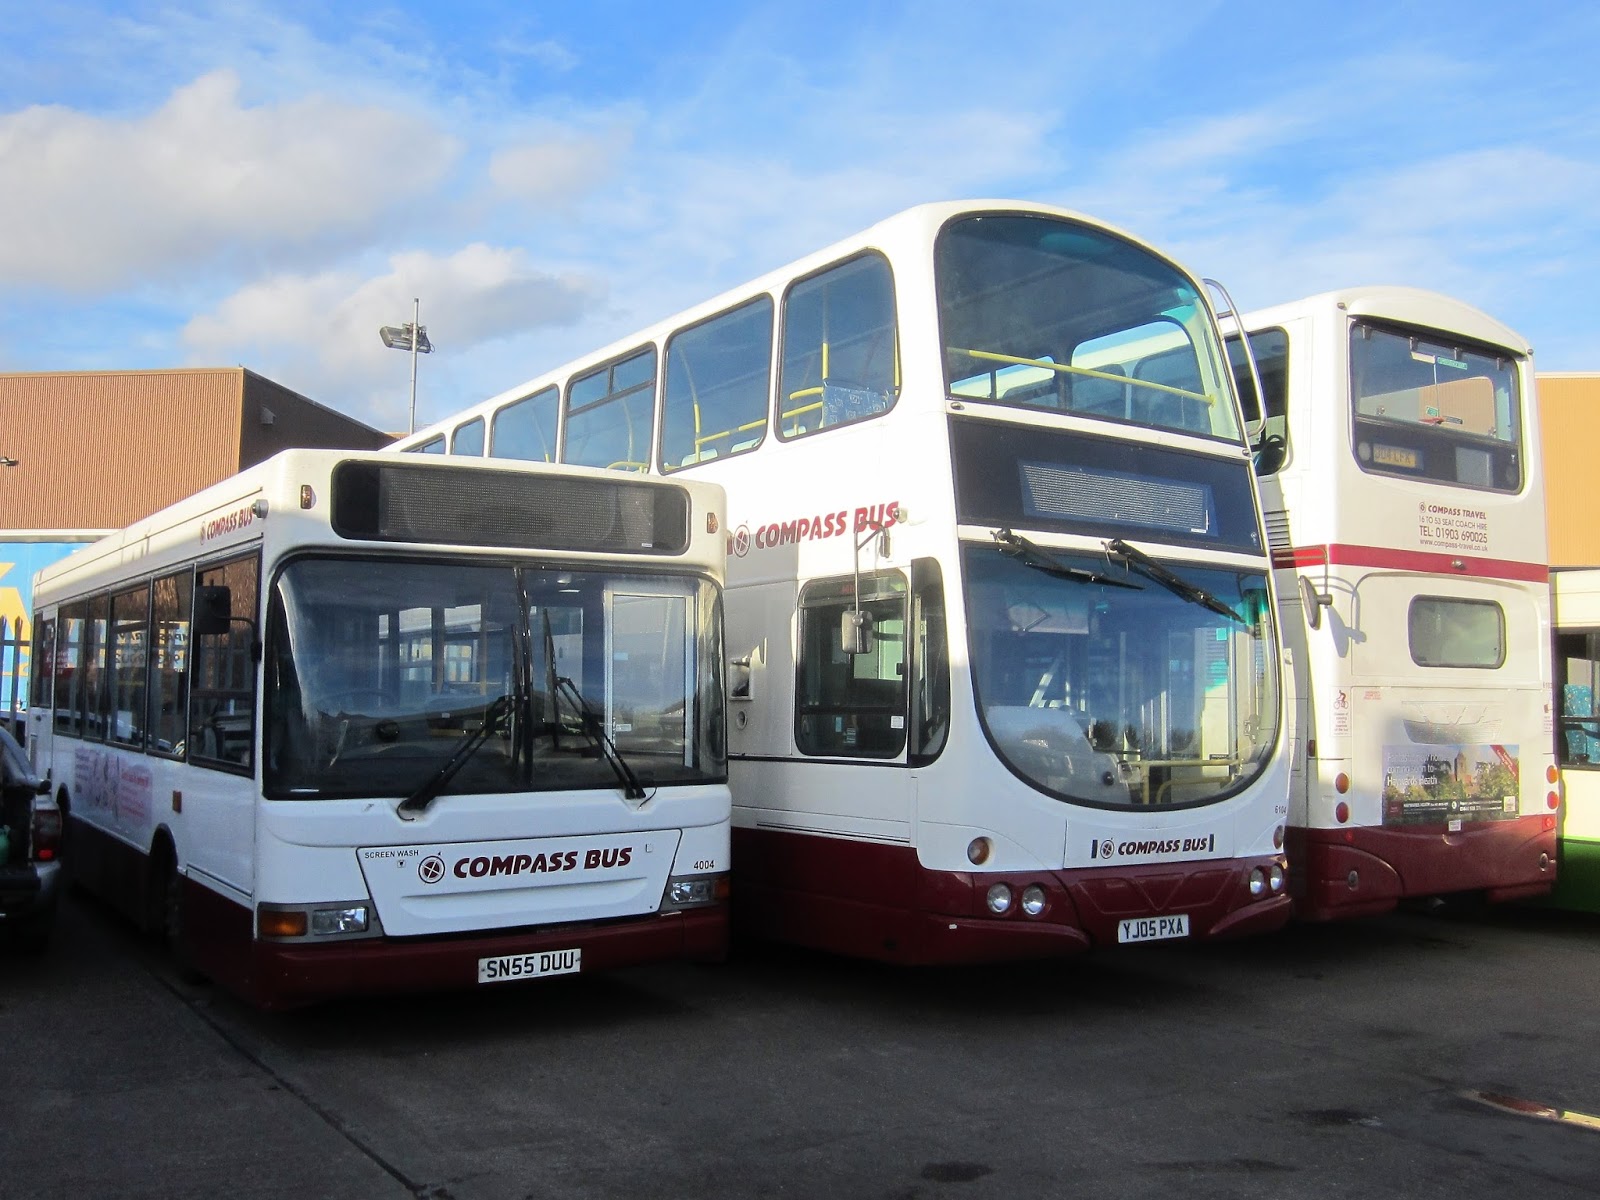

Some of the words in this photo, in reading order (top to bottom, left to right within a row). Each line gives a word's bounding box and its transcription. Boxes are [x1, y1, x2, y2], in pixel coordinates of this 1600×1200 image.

[1427, 504, 1461, 516] COMPASS
[1462, 509, 1487, 520] TRAVEL
[206, 512, 238, 540] COMPASS
[238, 507, 254, 528] BUS
[755, 510, 848, 550] COMPASS
[853, 501, 899, 534] BUS
[1426, 516, 1434, 524] TO
[1442, 518, 1455, 527] SEAT
[1456, 521, 1476, 529] COACH
[1476, 523, 1488, 531] HIRE
[1419, 525, 1434, 537] TEL:
[1435, 527, 1459, 540] 01903
[1461, 530, 1488, 543] 690025
[1419, 538, 1489, 552] www.compass-travel.co.uk
[1274, 805, 1287, 814] 6104
[364, 851, 395, 859] SCREEN
[397, 849, 419, 857] WASH
[1117, 839, 1180, 855] COMPASS
[1182, 837, 1208, 852] BUS
[453, 851, 577, 879] COMPASS
[584, 847, 633, 870] BUS
[693, 859, 715, 870] 4004
[1123, 920, 1157, 939] YJ05
[1159, 917, 1184, 935] PXA
[486, 957, 534, 978] SN55
[539, 951, 575, 971] DUU
